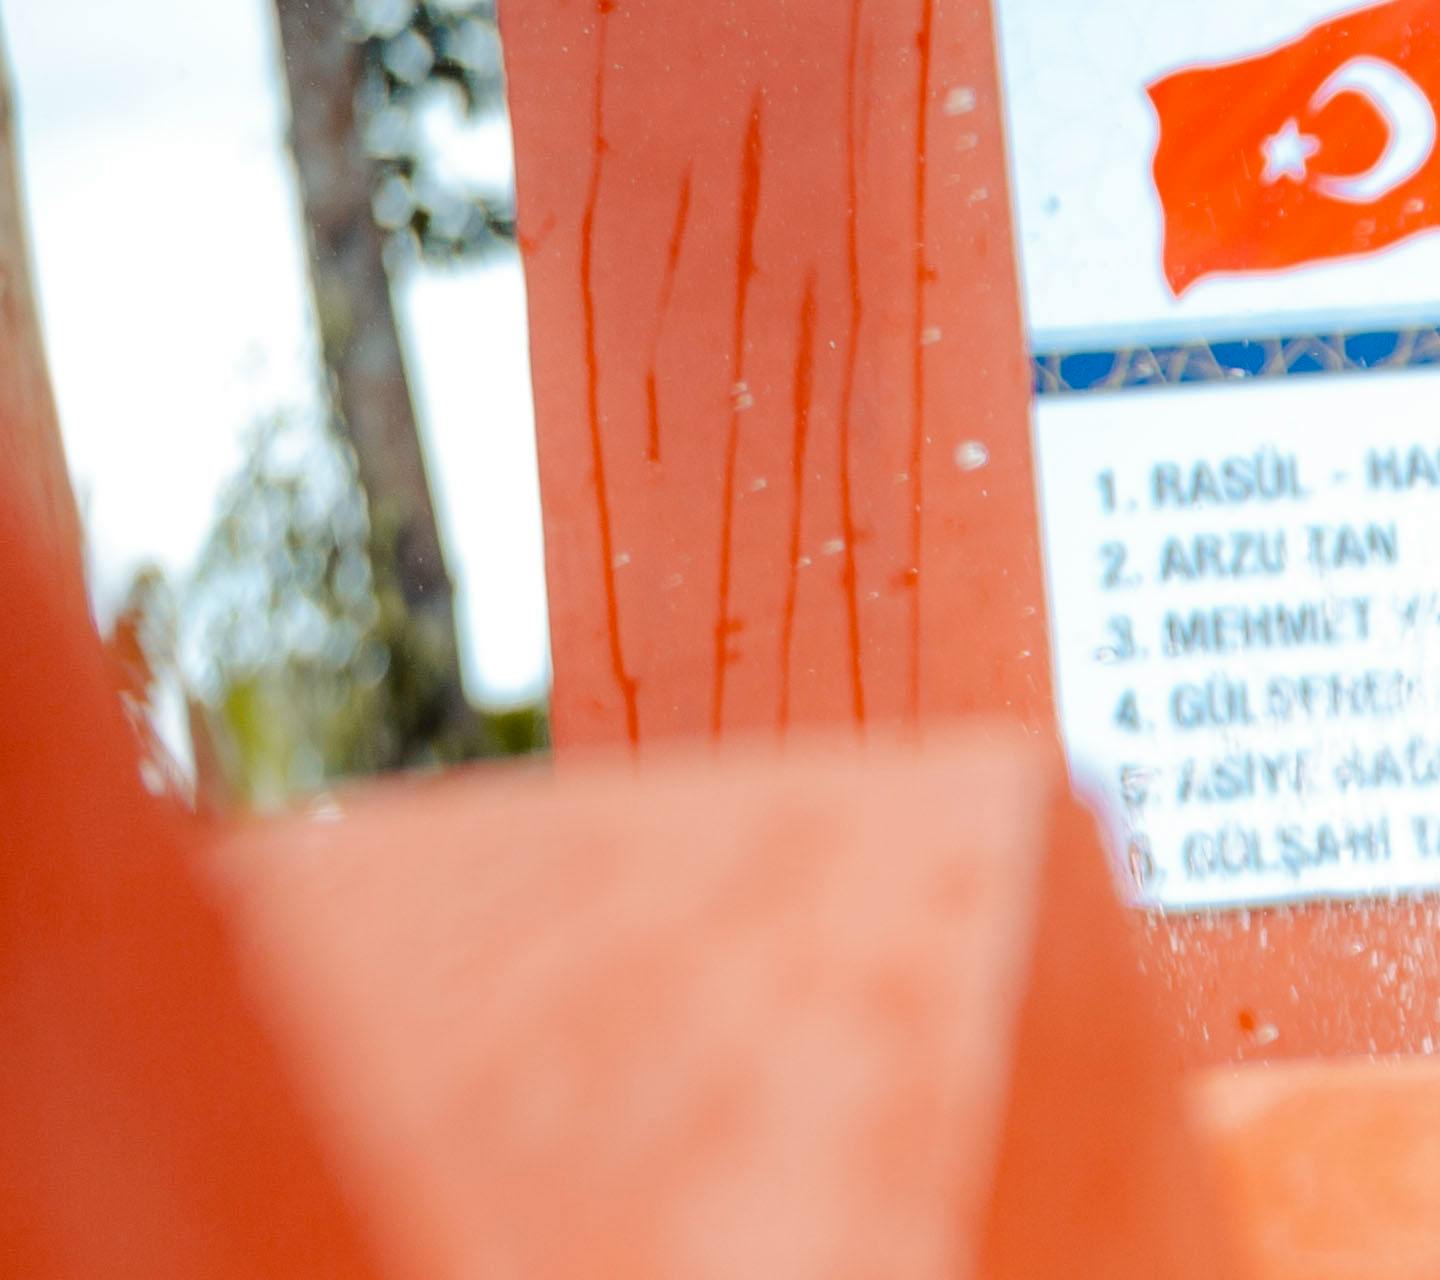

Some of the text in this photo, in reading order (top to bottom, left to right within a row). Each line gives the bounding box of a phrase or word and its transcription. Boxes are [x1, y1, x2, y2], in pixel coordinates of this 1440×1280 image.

[1098, 470, 1137, 513] 1.
[1150, 446, 1308, 507] RASÜL
[1101, 521, 1399, 590] 2. ARZU TAN
[1163, 600, 1368, 656] MEHMET
